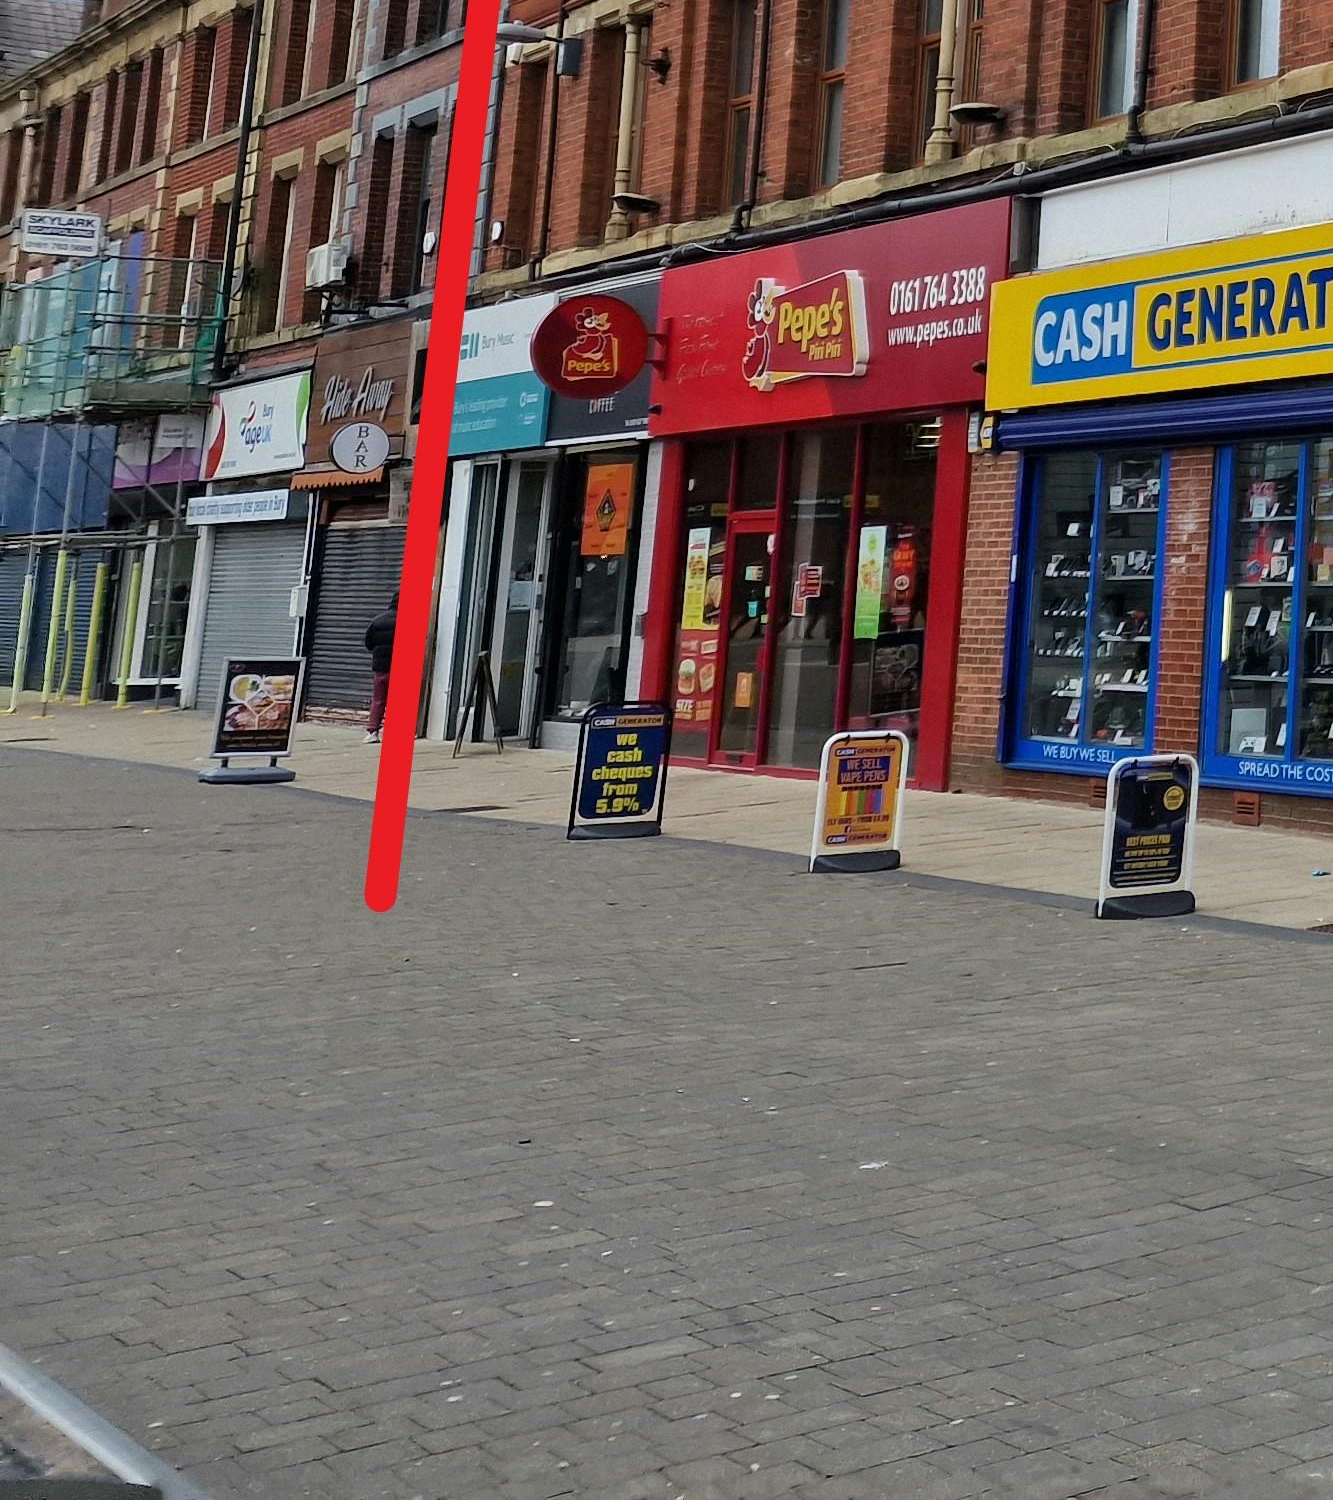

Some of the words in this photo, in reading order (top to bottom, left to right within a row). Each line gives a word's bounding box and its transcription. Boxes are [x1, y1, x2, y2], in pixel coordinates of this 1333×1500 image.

[29, 215, 96, 227] SKYLARK
[889, 281, 921, 316] 0161
[922, 275, 947, 311] 764
[949, 266, 986, 304] 3388
[776, 287, 844, 353] Pepe's
[887, 309, 982, 347] www.pepes.co.uk
[1034, 299, 1128, 368] CASH
[481, 334, 496, 350] Bury
[567, 359, 611, 375] Pepe's
[262, 404, 275, 420] Bury
[354, 425, 371, 468] BAR
[594, 718, 616, 727] CASH
[616, 733, 638, 746] we
[606, 747, 643, 763] cash
[836, 748, 856, 756] CASH
[1042, 744, 1058, 757] WE
[1059, 746, 1076, 760] BUY
[1076, 748, 1095, 761] WE
[1096, 750, 1116, 763] SELL
[846, 758, 860, 770] WE
[861, 757, 882, 770] SELL
[1238, 761, 1280, 779] SPREAD
[1280, 764, 1303, 780] THE
[591, 765, 653, 782] cheques
[840, 771, 862, 784] VAPE
[863, 770, 886, 783] PENS
[602, 782, 638, 797] from
[595, 797, 640, 814] 5.9%
